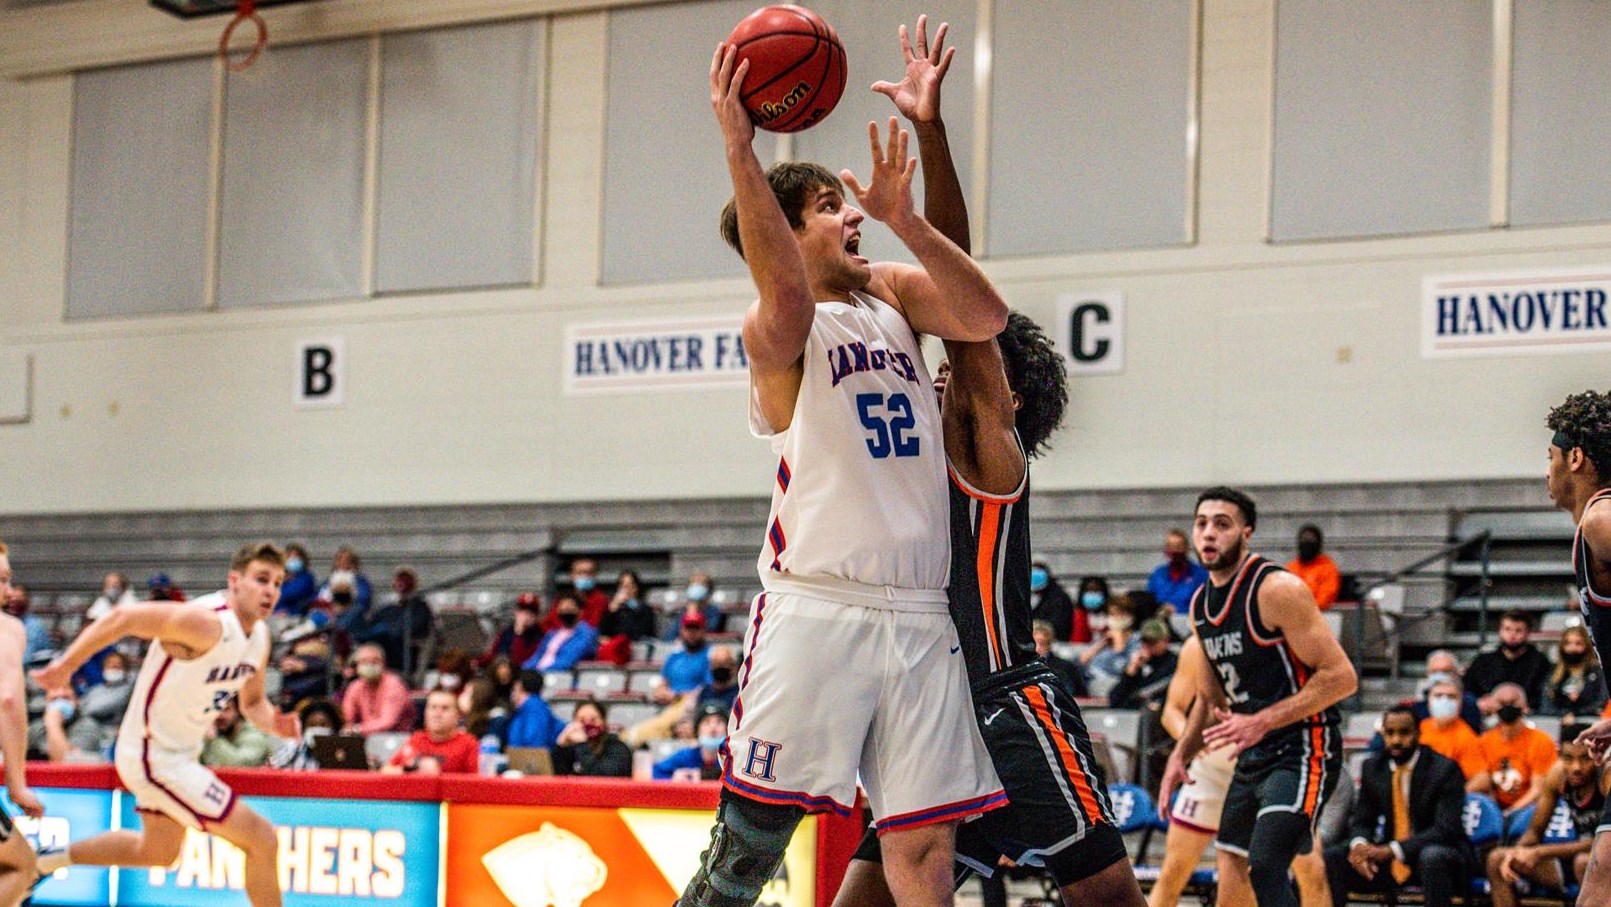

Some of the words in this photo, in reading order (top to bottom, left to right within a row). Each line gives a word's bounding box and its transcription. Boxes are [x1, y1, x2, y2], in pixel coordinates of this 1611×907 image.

[1070, 302, 1110, 363] C
[1436, 287, 1608, 337] HANOVER
[303, 346, 333, 397] B
[575, 335, 704, 376] HANOVER
[856, 392, 920, 459] 52
[742, 737, 782, 783] H
[148, 826, 405, 898] ANHERS
